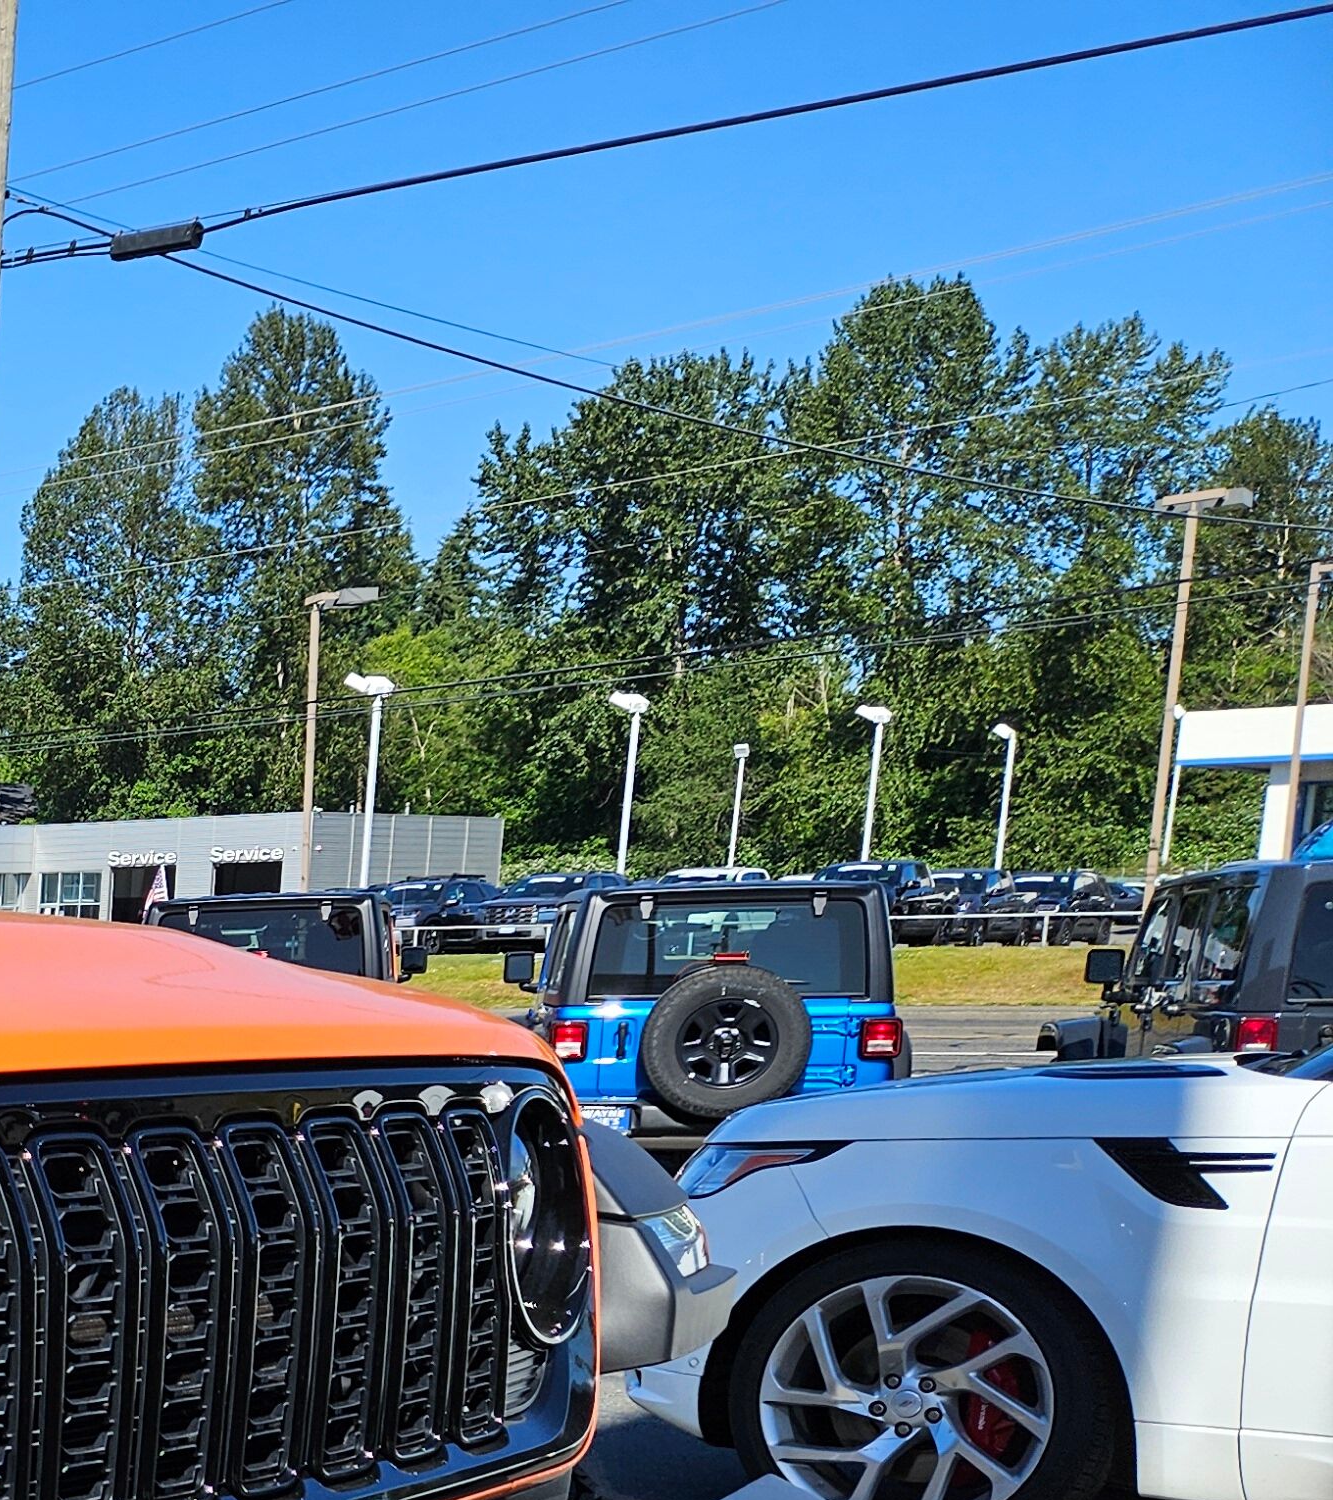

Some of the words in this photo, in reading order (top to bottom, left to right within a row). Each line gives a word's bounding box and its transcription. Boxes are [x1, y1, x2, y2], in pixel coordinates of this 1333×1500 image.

[108, 850, 177, 867] Service
[210, 845, 284, 863] Service
[581, 1109, 625, 1119] WAYNE
